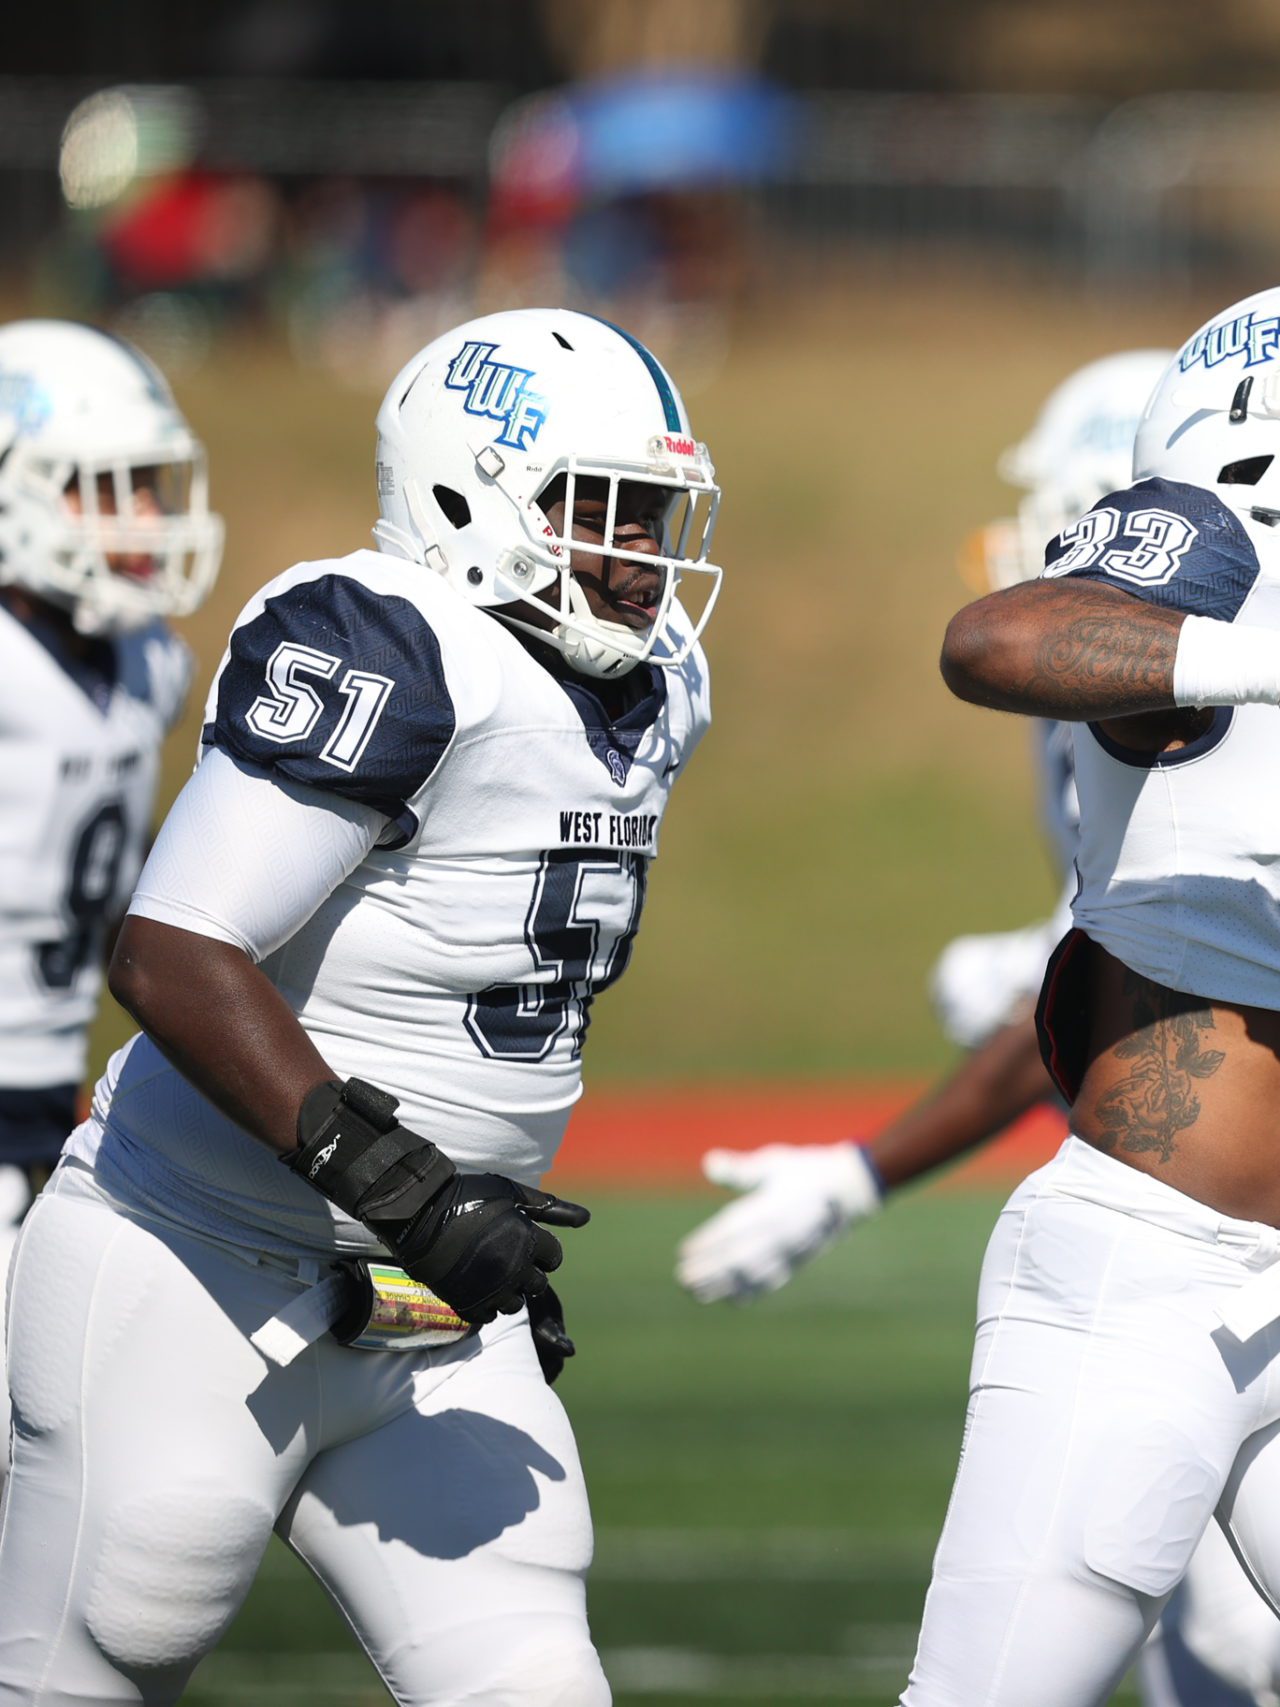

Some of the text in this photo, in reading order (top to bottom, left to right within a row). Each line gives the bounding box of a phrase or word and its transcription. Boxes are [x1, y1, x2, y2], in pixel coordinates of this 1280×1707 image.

[445, 341, 549, 451] UWF
[1040, 507, 1199, 586] 33
[245, 641, 395, 773] 51
[559, 811, 602, 843] WEST
